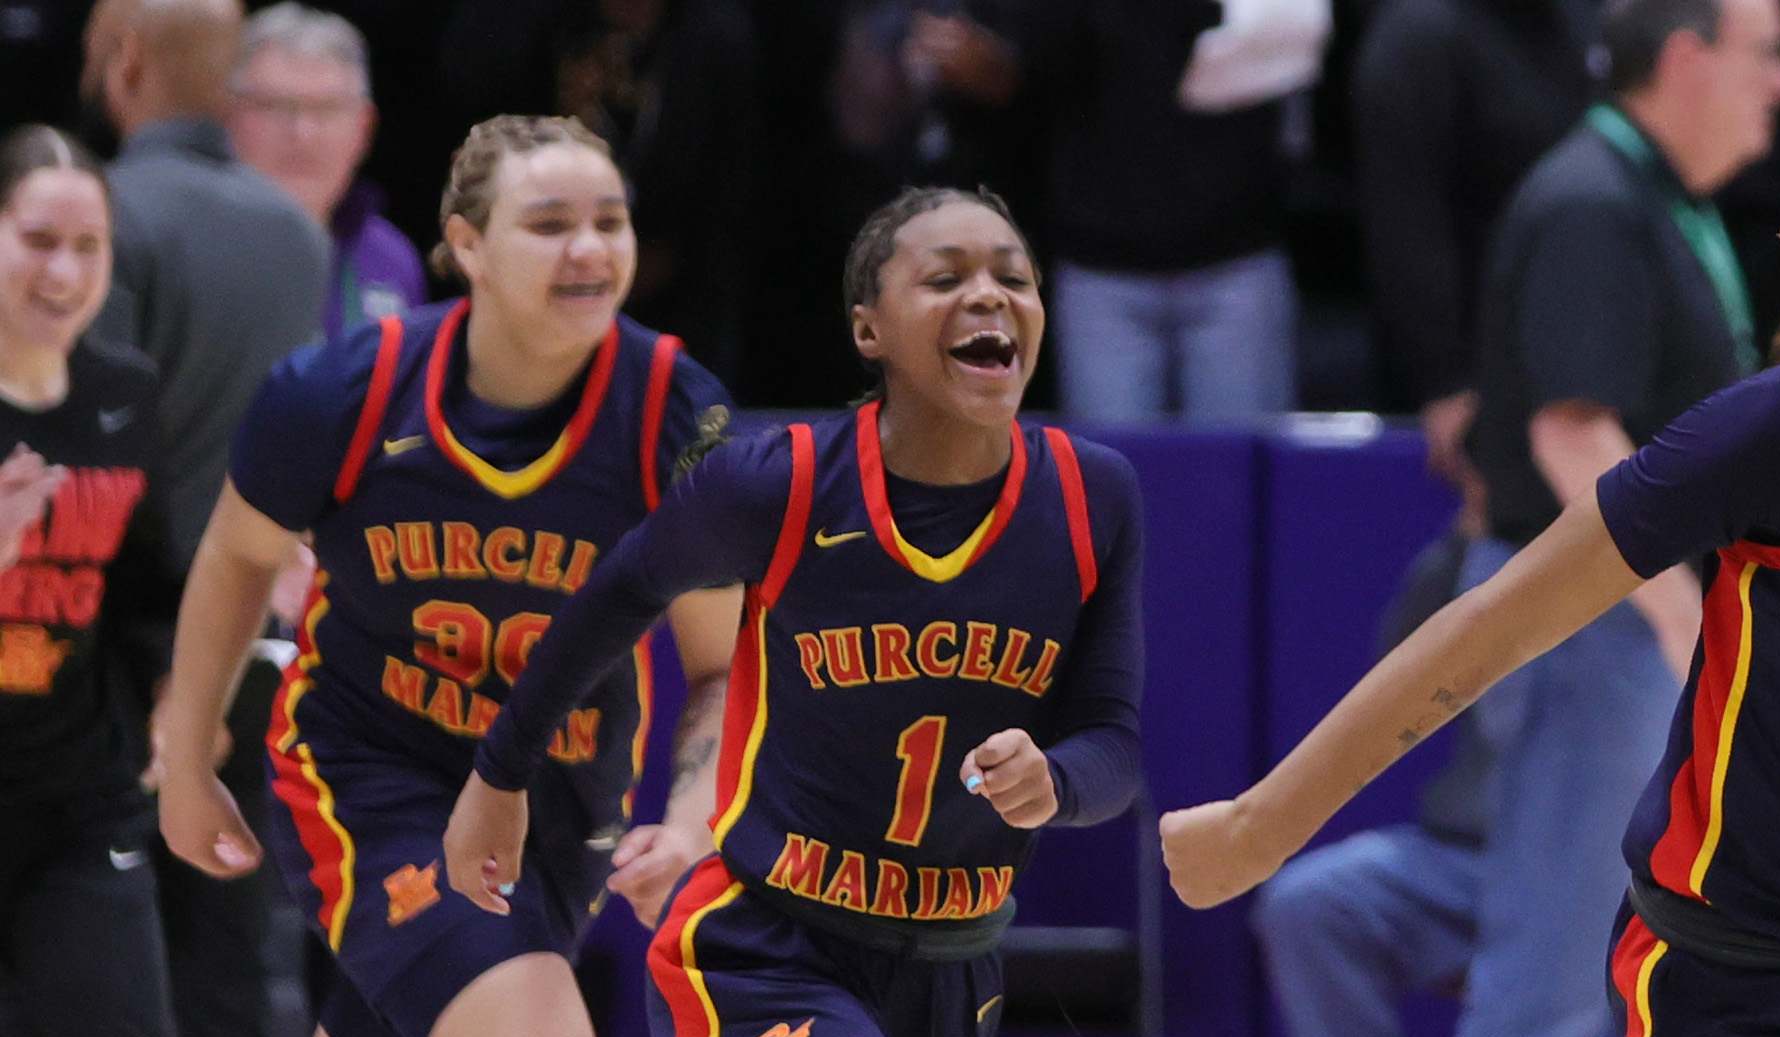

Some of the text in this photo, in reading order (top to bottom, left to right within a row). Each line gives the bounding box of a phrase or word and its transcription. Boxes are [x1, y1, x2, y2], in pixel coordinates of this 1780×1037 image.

[364, 521, 599, 595] PURCEL
[794, 620, 1061, 698] PURCELL
[381, 655, 601, 764] MARAN
[884, 715, 947, 847] 1
[765, 832, 1014, 920] MARIAN
